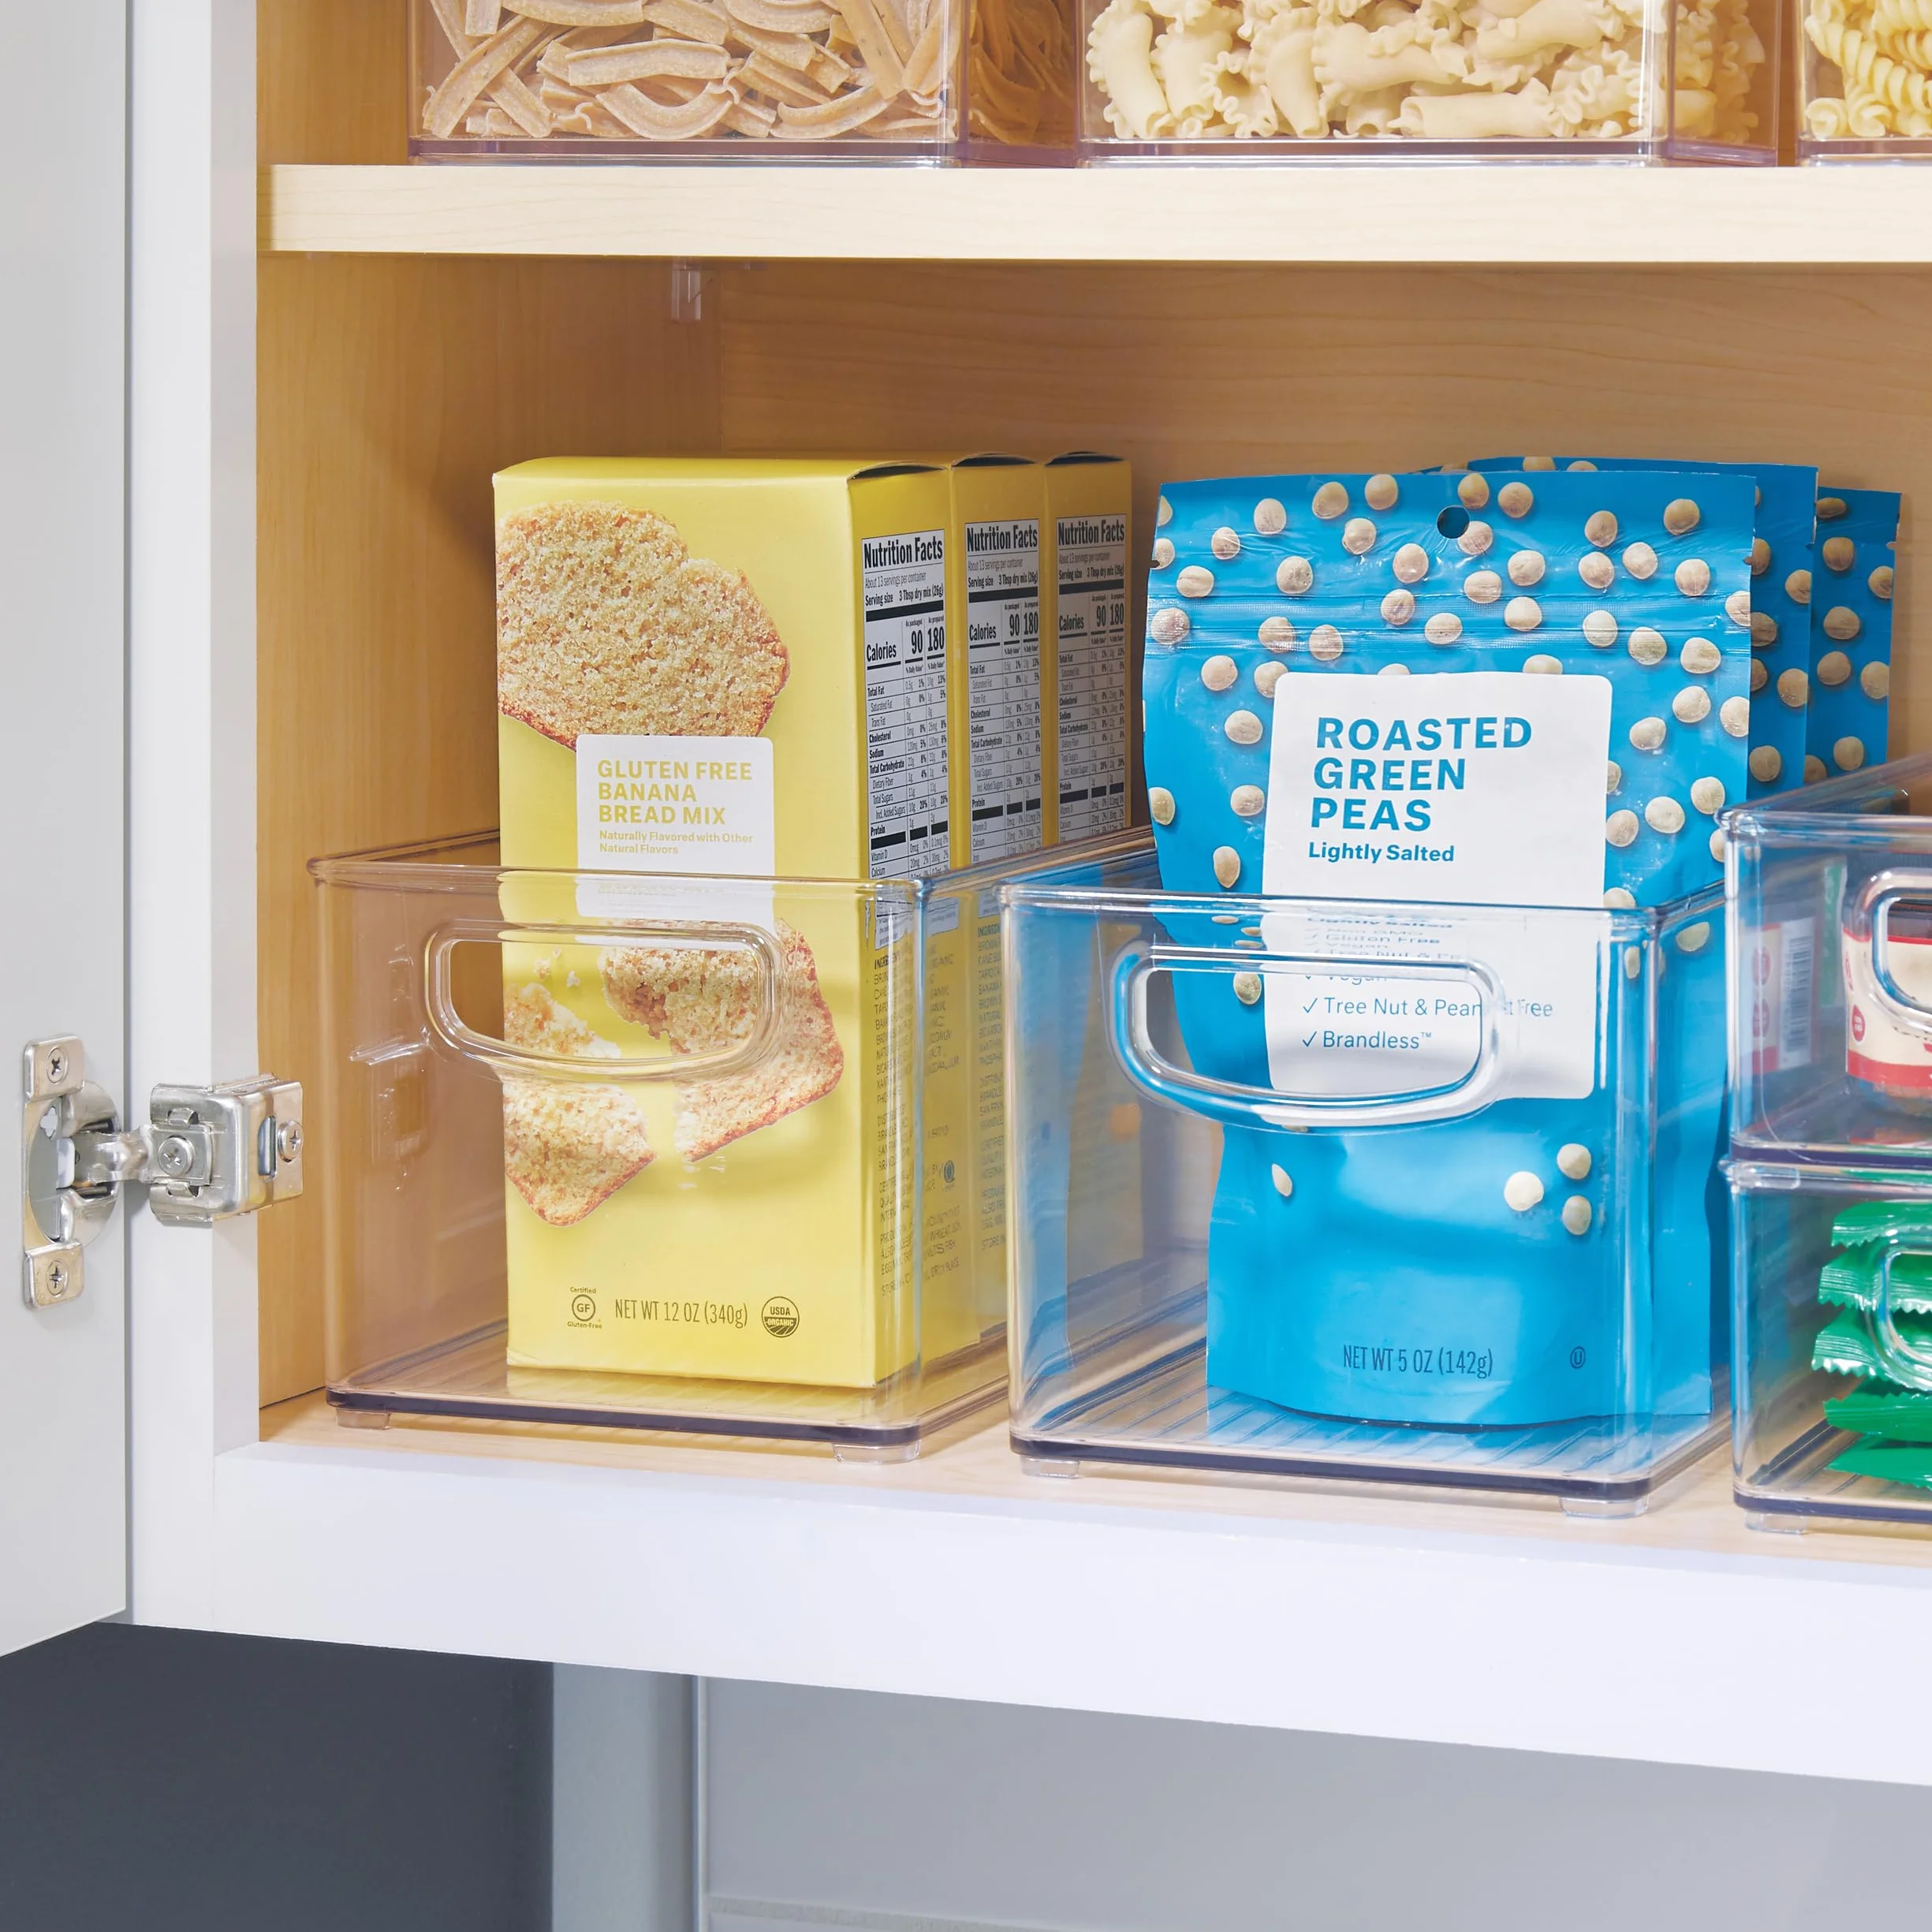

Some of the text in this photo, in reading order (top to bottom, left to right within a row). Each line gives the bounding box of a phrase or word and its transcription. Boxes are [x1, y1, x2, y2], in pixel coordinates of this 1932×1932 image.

[968, 524, 1038, 551] Nutrition Facts
[1058, 520, 1124, 546] Nutrition Facts
[864, 536, 942, 569] Nutrition Facts
[865, 577, 877, 588] About
[878, 576, 882, 587] 13
[884, 574, 900, 587] servings
[908, 571, 926, 583] container
[968, 576, 984, 588] Serving
[999, 575, 1001, 585] 3
[1002, 574, 1012, 586] Tbsp
[1059, 569, 1073, 580] Serving
[866, 594, 883, 606] Serving
[884, 592, 893, 603] size
[900, 591, 902, 601] 3
[904, 590, 913, 602] Tbsp
[932, 584, 943, 598] (26g)
[970, 612, 1038, 641] Calories 90 180
[1060, 603, 1124, 631] Calories 90 180
[867, 626, 944, 662] Calories 90 180
[867, 687, 877, 697] Total
[870, 731, 891, 743] Cholesterol
[1317, 718, 1531, 751] ROASTED
[870, 749, 883, 759] Sodium
[598, 760, 752, 780] GLUTEN FREE
[870, 764, 879, 774] Total
[880, 760, 904, 772] Carbohydrate
[1314, 757, 1465, 790] GREEN
[599, 783, 696, 802] BANANA
[873, 779, 884, 789] Dietary
[882, 794, 893, 804] Sugars
[599, 805, 725, 825] BREAD MIX
[1311, 797, 1430, 831] PEAS
[600, 830, 753, 843] Naturally Flavored with Other
[871, 825, 885, 836] Protein
[600, 844, 678, 854] Natural Flavors
[885, 850, 887, 859] D
[1309, 842, 1454, 863] Lightly Salted
[872, 867, 885, 877] Calcium
[1324, 998, 1366, 1014] Tree
[1374, 998, 1408, 1015] Nut
[1415, 999, 1427, 1015] &
[1518, 999, 1553, 1017] Free
[577, 1304, 590, 1312] GF
[616, 1300, 748, 1329] NET WT 12 OZ (340g)
[770, 1307, 790, 1315] USDA
[1344, 1345, 1493, 1378] NET WT 5 OZ (142g)
